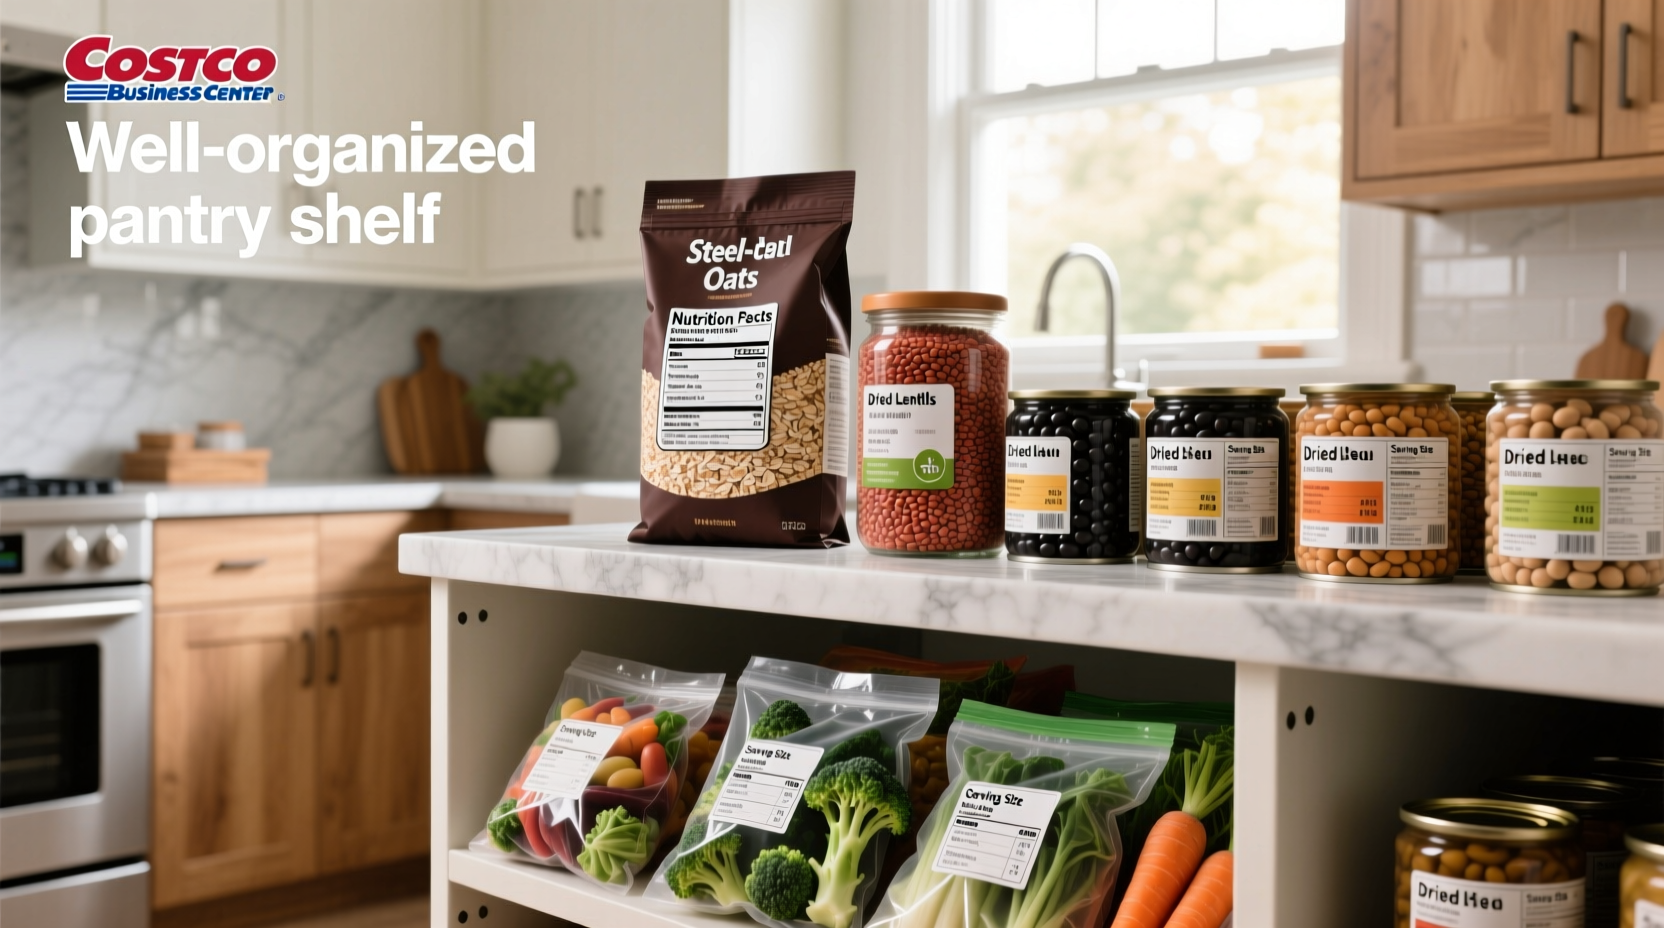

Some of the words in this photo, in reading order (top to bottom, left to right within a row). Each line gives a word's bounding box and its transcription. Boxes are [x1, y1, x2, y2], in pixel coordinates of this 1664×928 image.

[703, 266, 759, 291] Oats
[671, 311, 734, 326] Nutrition
[1304, 445, 1337, 461] Dried
[1504, 448, 1546, 465] Dried
[1418, 881, 1460, 906] Dried
